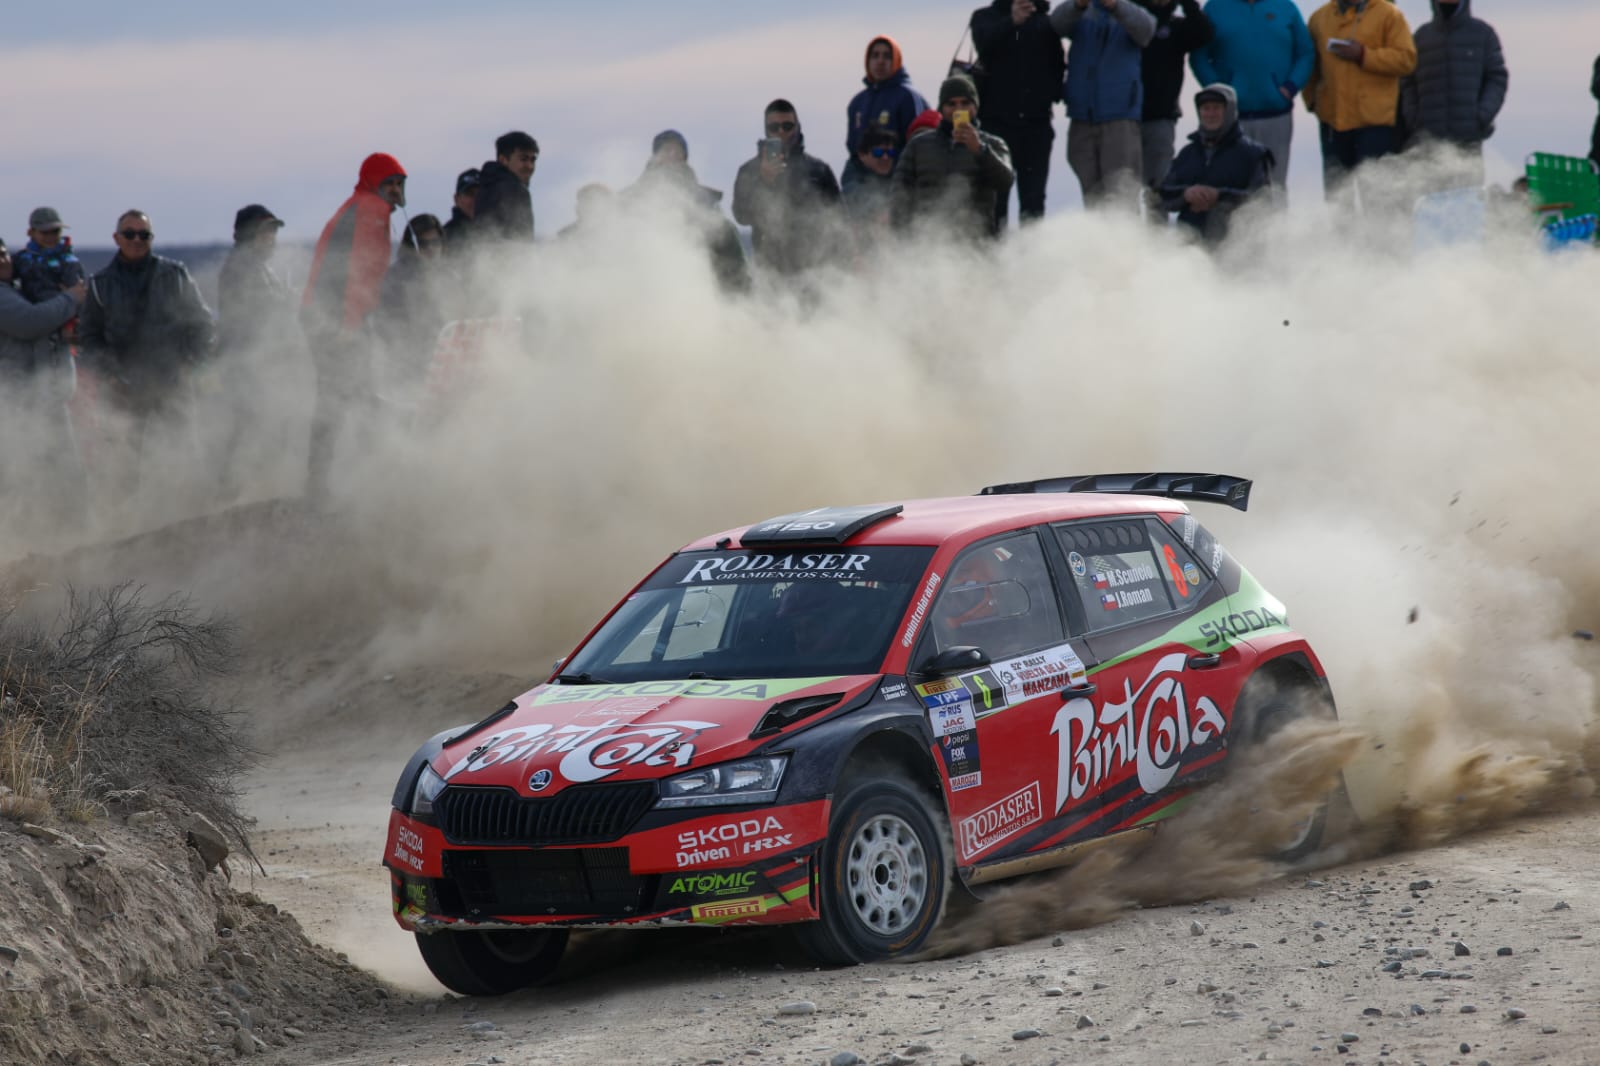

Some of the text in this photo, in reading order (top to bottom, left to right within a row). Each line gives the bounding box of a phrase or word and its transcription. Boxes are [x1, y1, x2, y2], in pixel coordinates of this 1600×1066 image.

[676, 554, 871, 584] RODASER
[1163, 543, 1189, 598] 6
[901, 572, 941, 648] @pointcolaracing
[1199, 607, 1282, 648] SKODA
[1015, 661, 1068, 681] VUELTA DE LA
[1022, 655, 1047, 667] RALLY
[973, 675, 992, 708] 6
[1022, 671, 1072, 697] MANZANA
[934, 690, 960, 705] YPF
[947, 704, 962, 714] RUS
[943, 717, 965, 729] JAC
[951, 734, 970, 746] pepsi
[951, 746, 966, 758] FOX
[678, 815, 784, 849] SKODA
[964, 790, 1035, 854] RODASER
[398, 825, 423, 854] SKODA
[676, 833, 793, 868] Driven HRX
[668, 871, 757, 895] ATOMIC
[698, 900, 760, 918] PIRELLI
